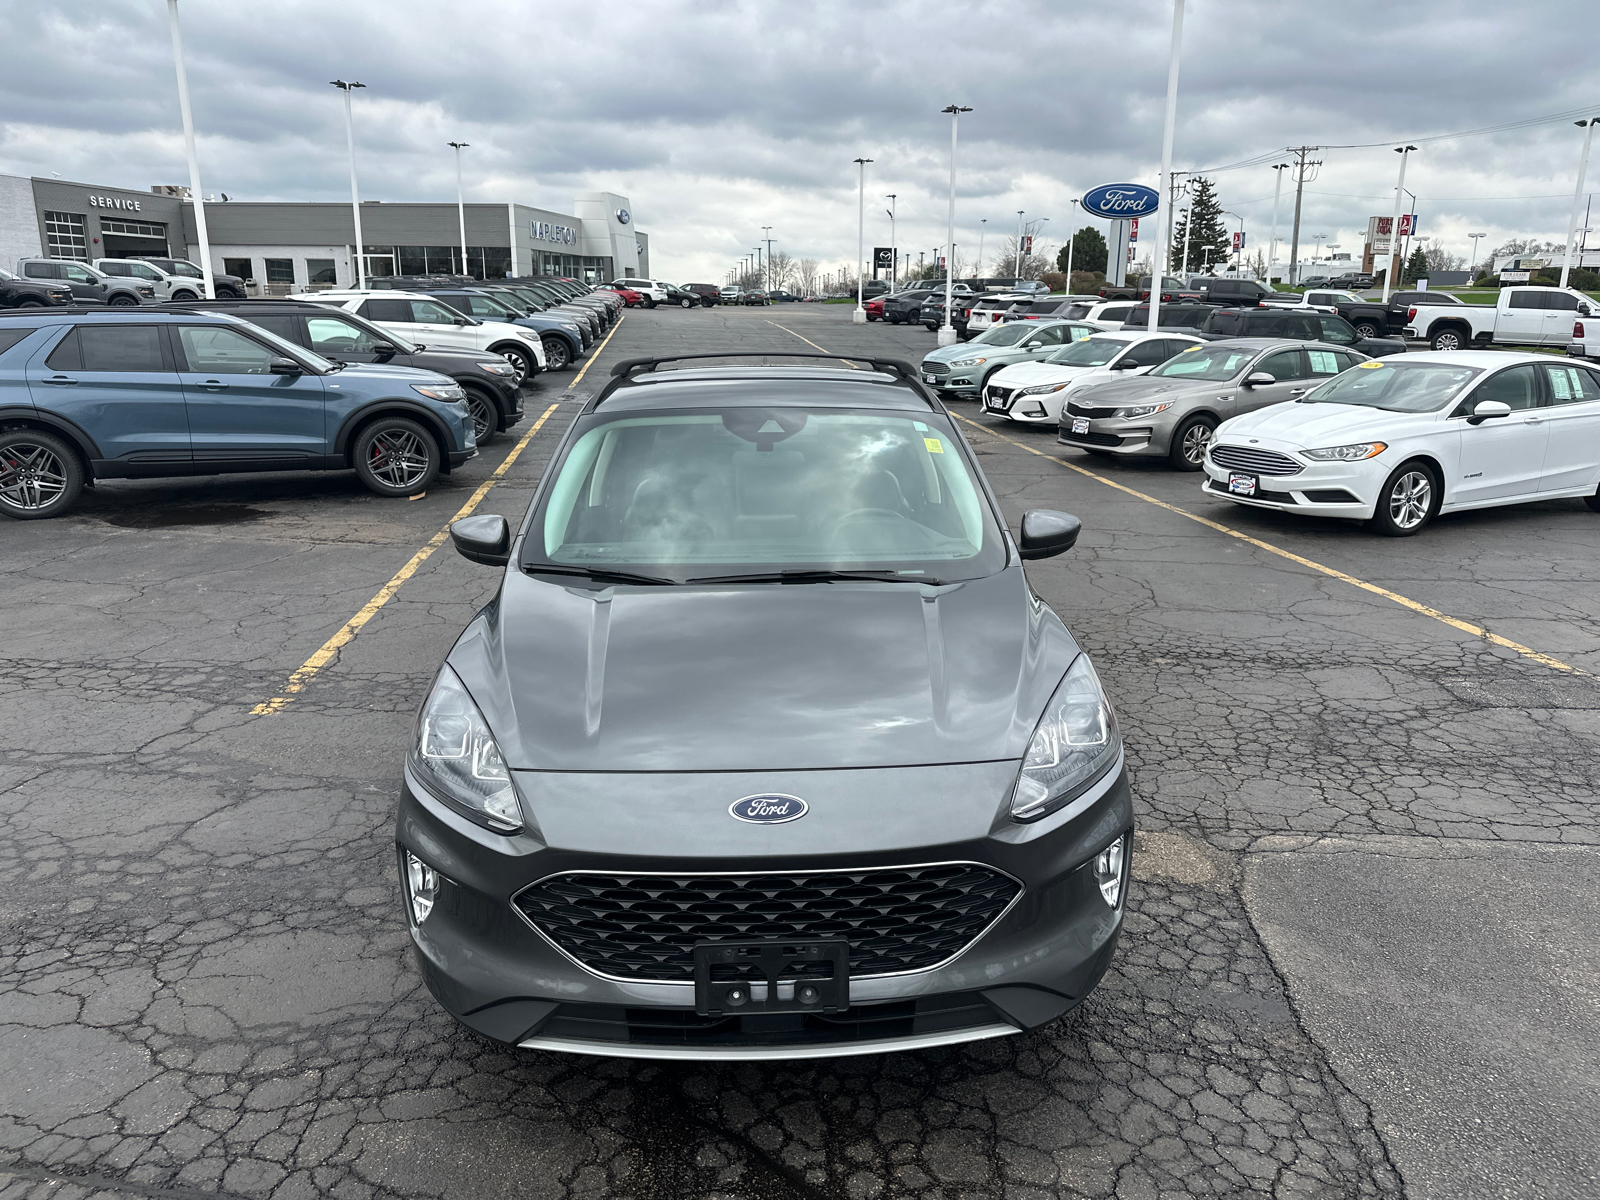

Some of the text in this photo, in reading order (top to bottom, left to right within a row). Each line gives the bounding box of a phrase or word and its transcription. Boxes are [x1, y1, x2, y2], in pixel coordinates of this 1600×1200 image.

[90, 195, 141, 211] SERVICE
[1100, 189, 1148, 211] Ford
[530, 220, 577, 245] NAPLETON
[747, 799, 790, 816] Ford
